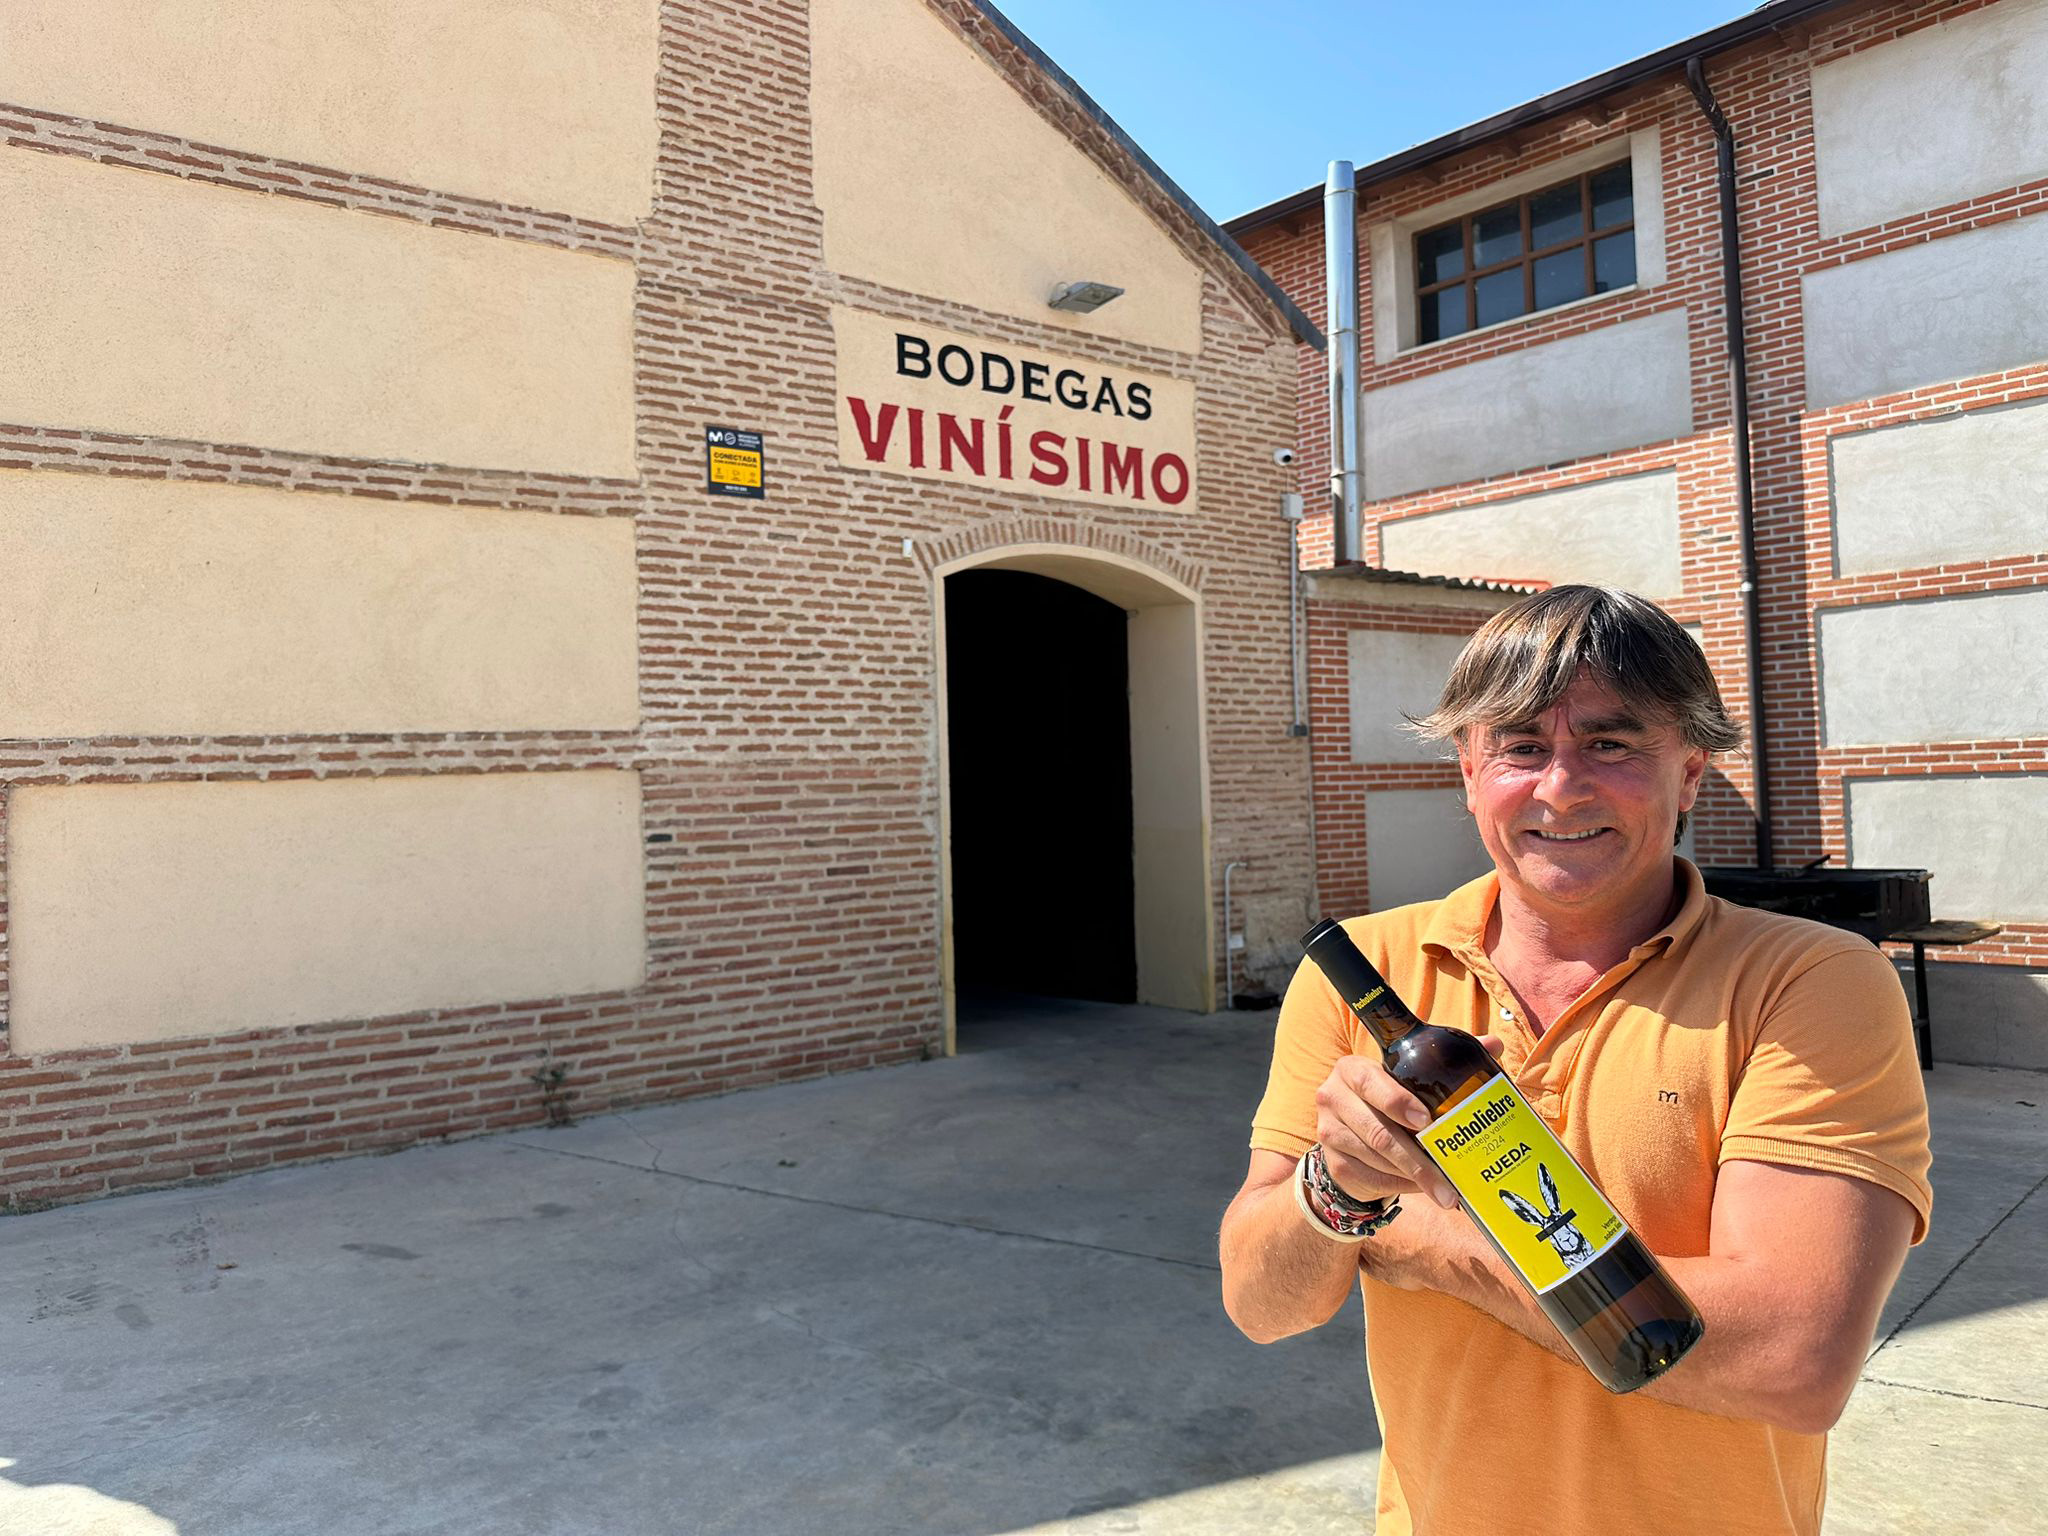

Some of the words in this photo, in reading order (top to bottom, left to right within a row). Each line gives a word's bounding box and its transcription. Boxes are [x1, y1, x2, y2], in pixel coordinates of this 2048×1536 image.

[895, 333, 1152, 421] BODEGAS
[846, 396, 1189, 505] VINÍSIMO
[1352, 986, 1384, 1011] Pecholiebre
[1434, 1094, 1516, 1157] Pecholiebre
[1456, 1152, 1464, 1160] el
[1464, 1134, 1491, 1154] verdejo
[1490, 1113, 1516, 1135] valiente
[1482, 1135, 1506, 1156] 2024
[1480, 1141, 1532, 1183] RUEDA
